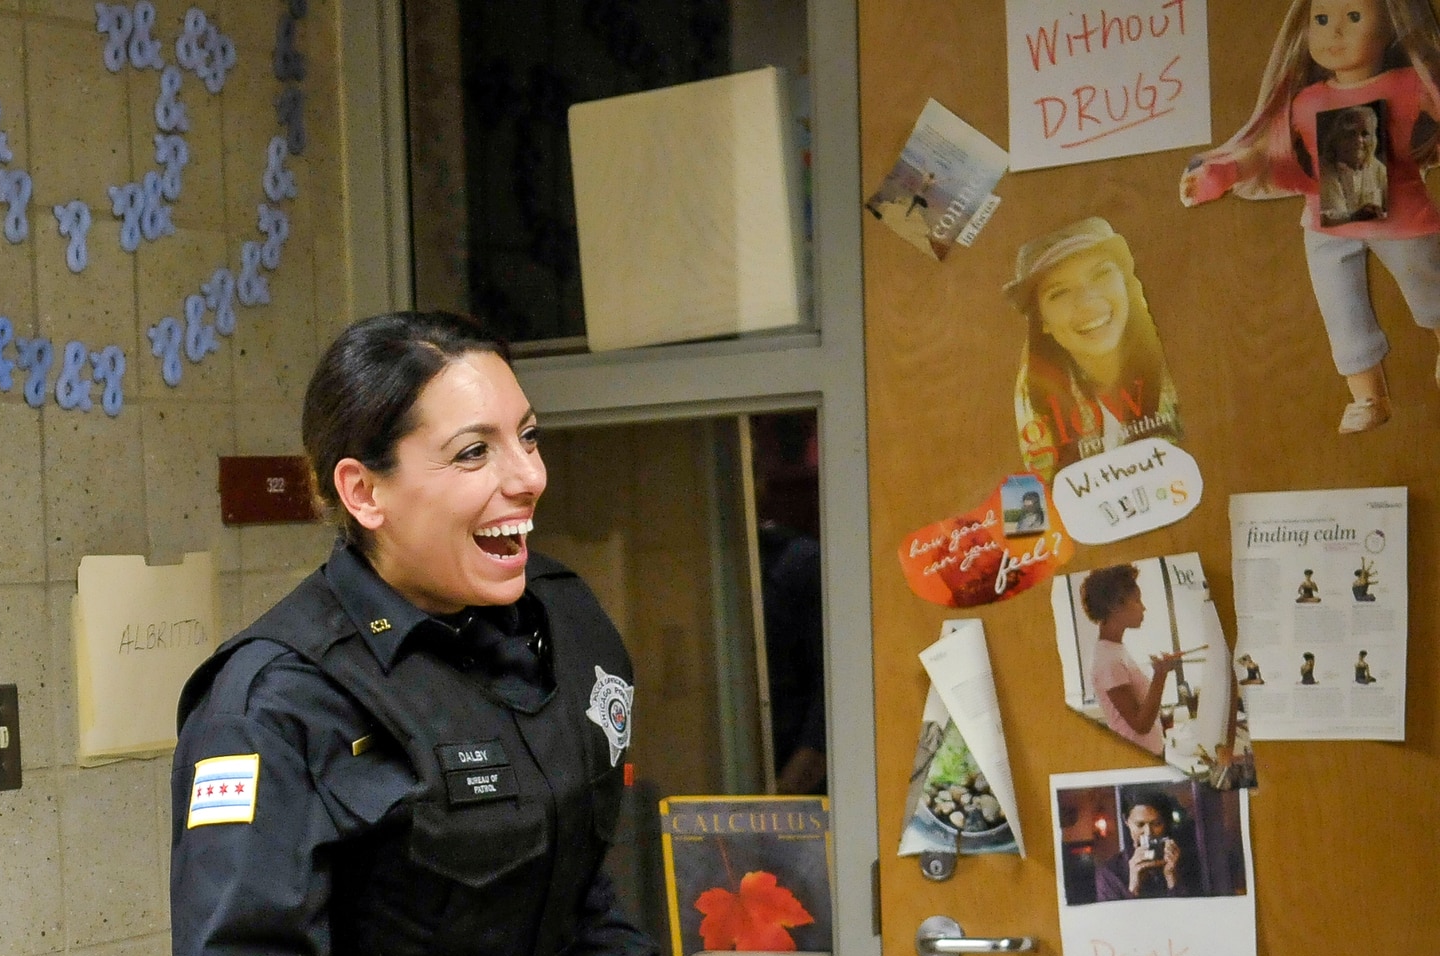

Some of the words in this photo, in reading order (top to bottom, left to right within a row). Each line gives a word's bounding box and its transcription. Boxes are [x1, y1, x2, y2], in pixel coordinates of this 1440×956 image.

[1034, 55, 1183, 139] DRUGS
[1065, 447, 1166, 498] Without
[910, 535, 945, 558] how
[948, 510, 998, 552] good
[1247, 526, 1310, 549] finding
[1313, 524, 1357, 542] calm
[923, 556, 956, 576] can
[960, 540, 999, 572] you
[994, 532, 1063, 595] feel?
[458, 750, 488, 763] DALBY
[466, 775, 490, 786] BUREAU
[490, 774, 498, 783] OF
[473, 784, 497, 795] PATROL
[672, 812, 822, 834] CALCULUS
